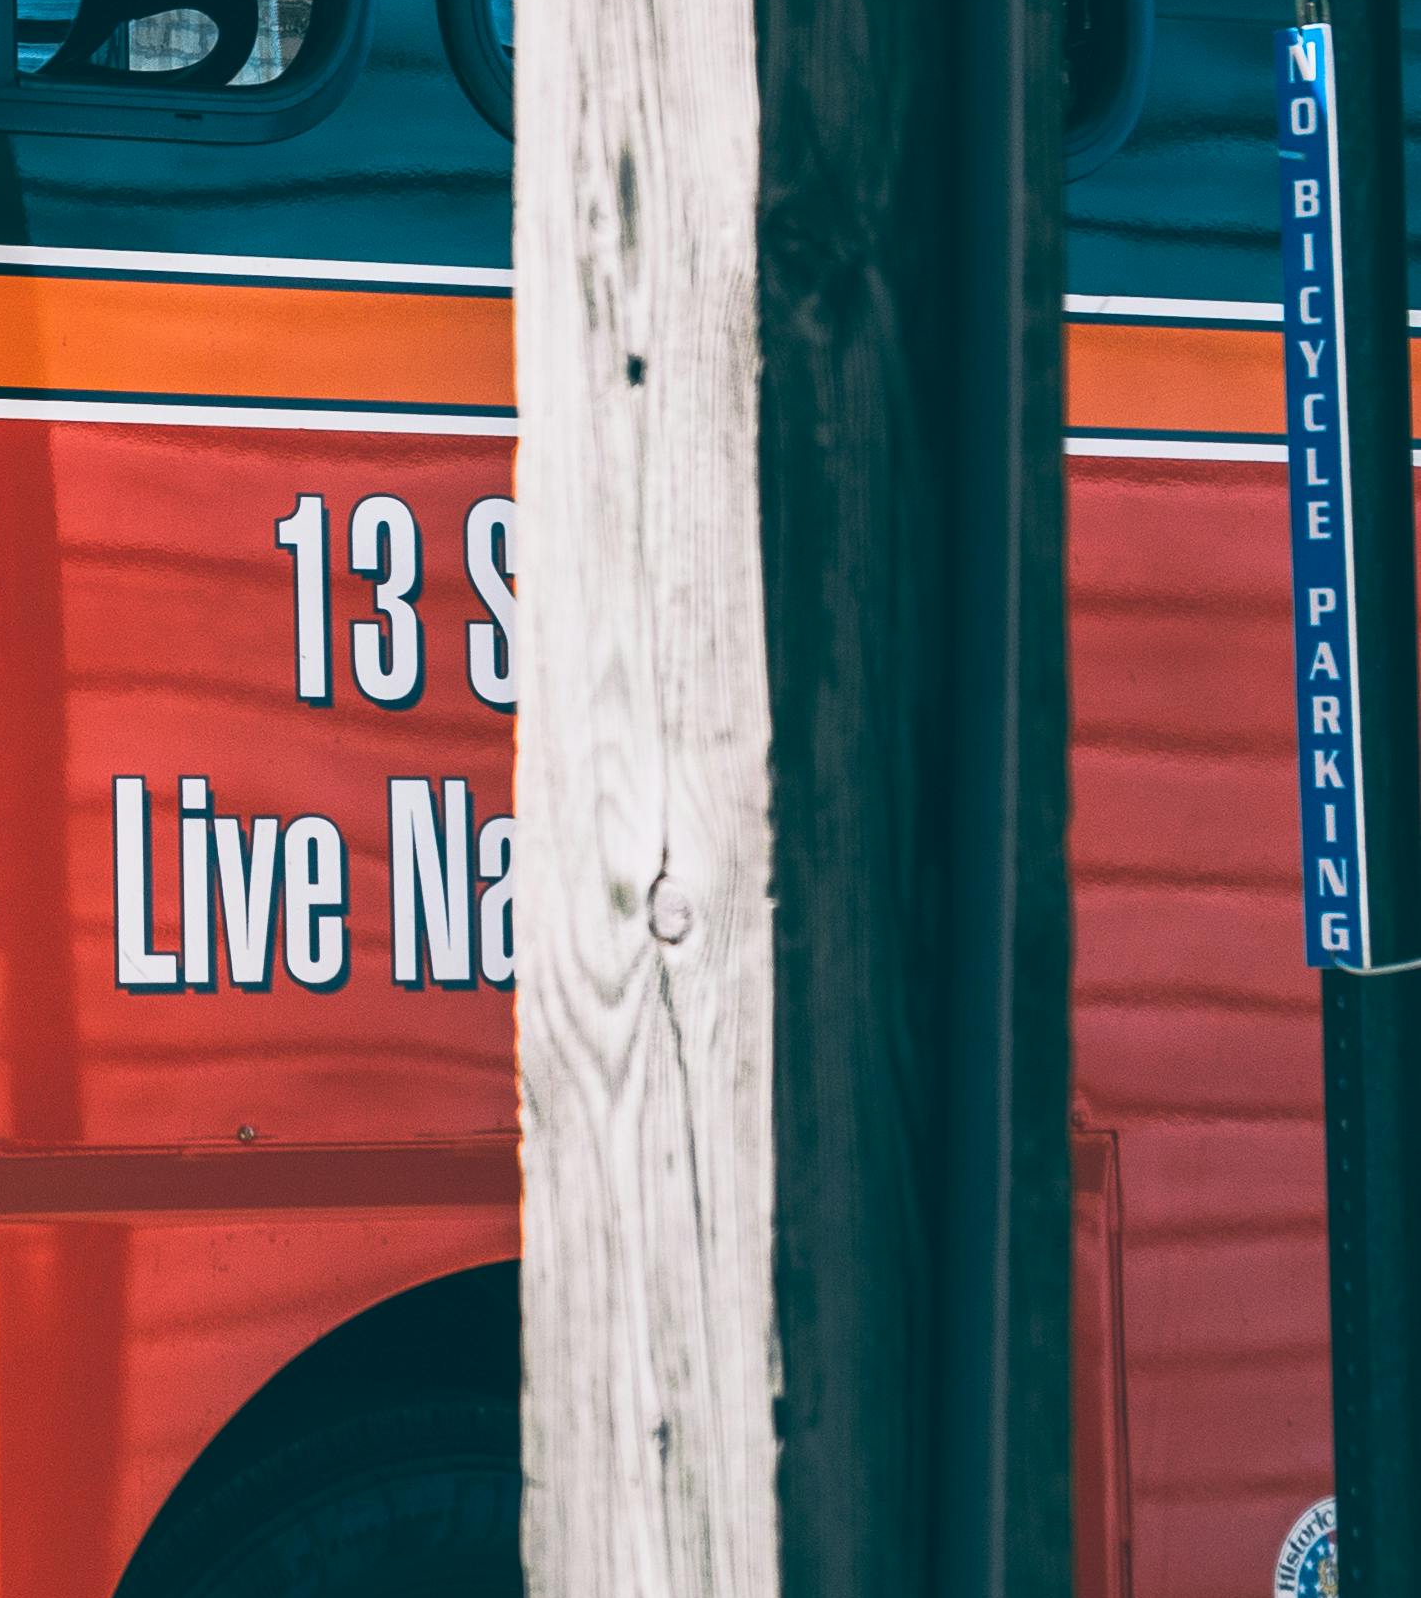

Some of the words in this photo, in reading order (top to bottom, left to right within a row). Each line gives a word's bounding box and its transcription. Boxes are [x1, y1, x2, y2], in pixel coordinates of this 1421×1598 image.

[1286, 40, 1319, 136] NO
[1292, 176, 1333, 541] BICYCLE
[274, 492, 425, 710] 13
[1307, 586, 1352, 953] PARKING
[111, 774, 352, 995] Live
[387, 774, 518, 994] Na
